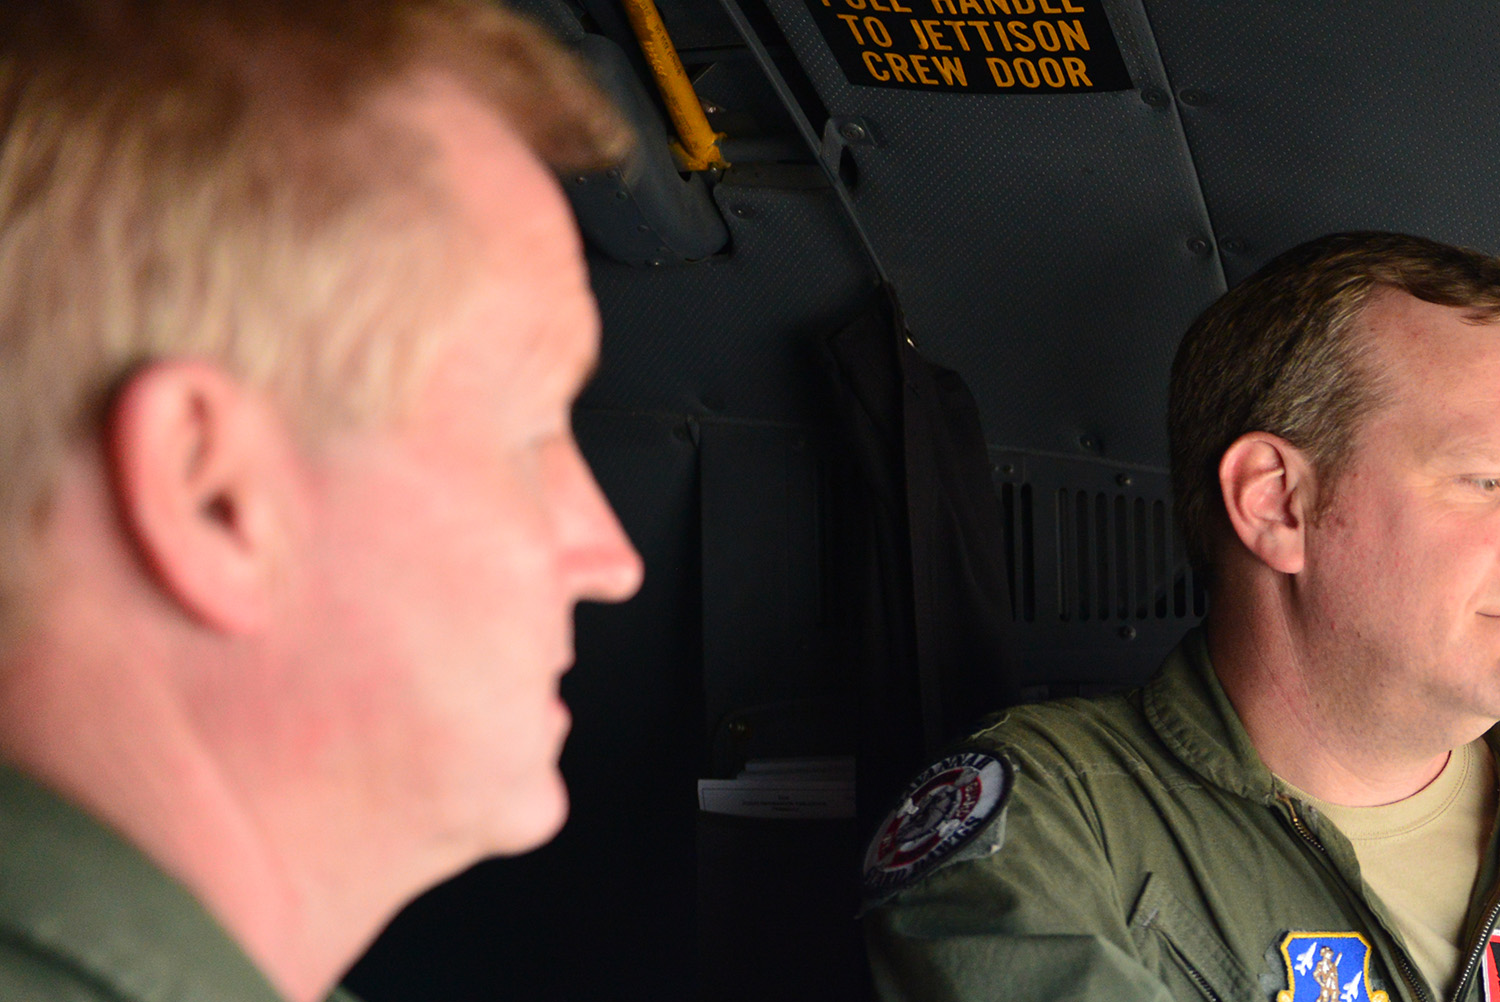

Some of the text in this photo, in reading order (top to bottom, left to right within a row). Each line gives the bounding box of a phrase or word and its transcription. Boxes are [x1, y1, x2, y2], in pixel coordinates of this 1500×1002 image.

[836, 13, 1091, 52] TO JETTISON
[862, 51, 1093, 89] CREW DOOR
